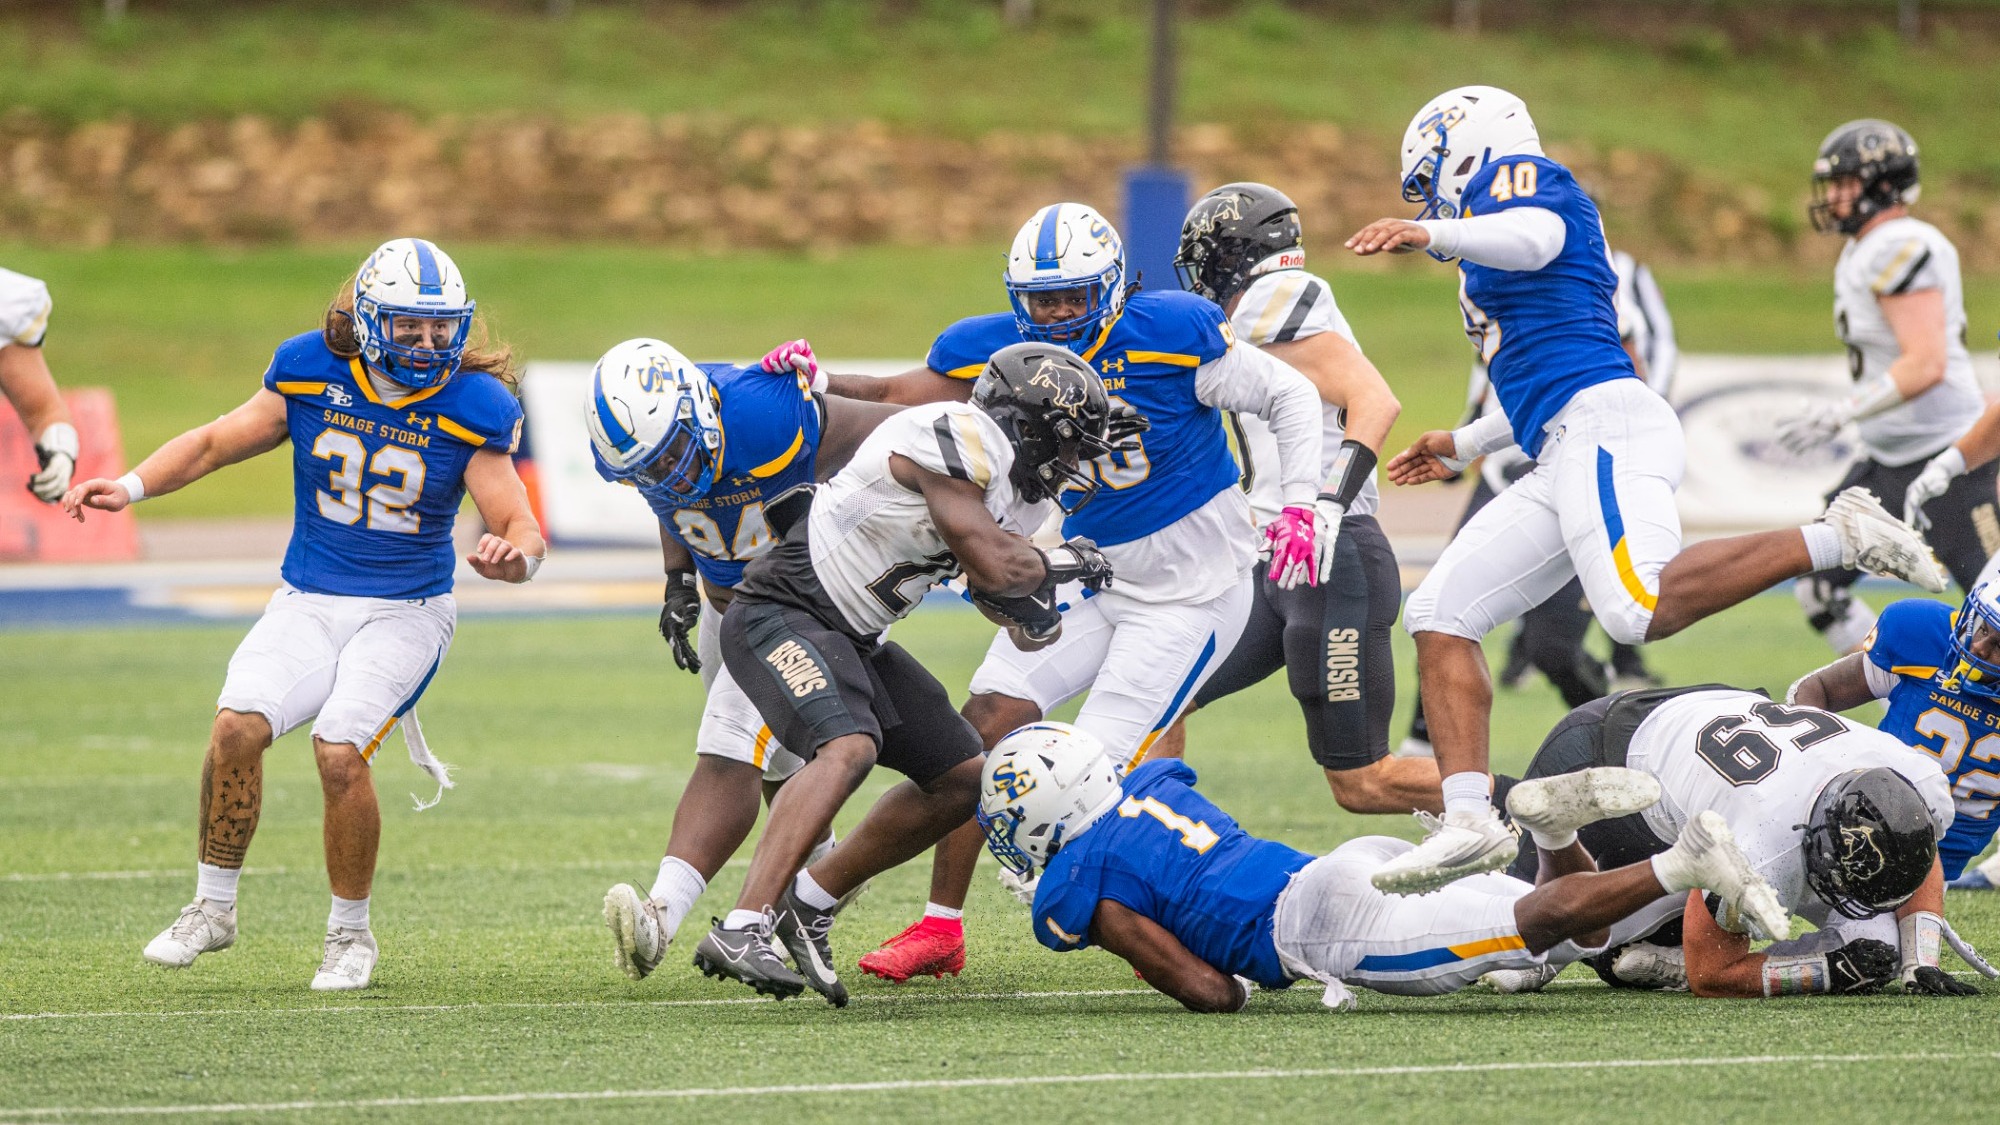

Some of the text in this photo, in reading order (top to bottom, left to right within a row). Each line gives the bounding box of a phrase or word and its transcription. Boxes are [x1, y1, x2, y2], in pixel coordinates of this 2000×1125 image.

[1490, 161, 1538, 202] 40
[326, 383, 353, 407] SE
[323, 409, 431, 448] SAVAGE STORM
[311, 427, 427, 534] 32
[714, 486, 763, 507] STORM
[672, 501, 779, 561] 94
[766, 640, 828, 698] BISONS
[1326, 627, 1361, 702] BISONS
[1929, 691, 1982, 722] SAVAGE
[992, 760, 1039, 804] SE
[1913, 707, 2000, 820] 22
[1117, 794, 1221, 856] 1
